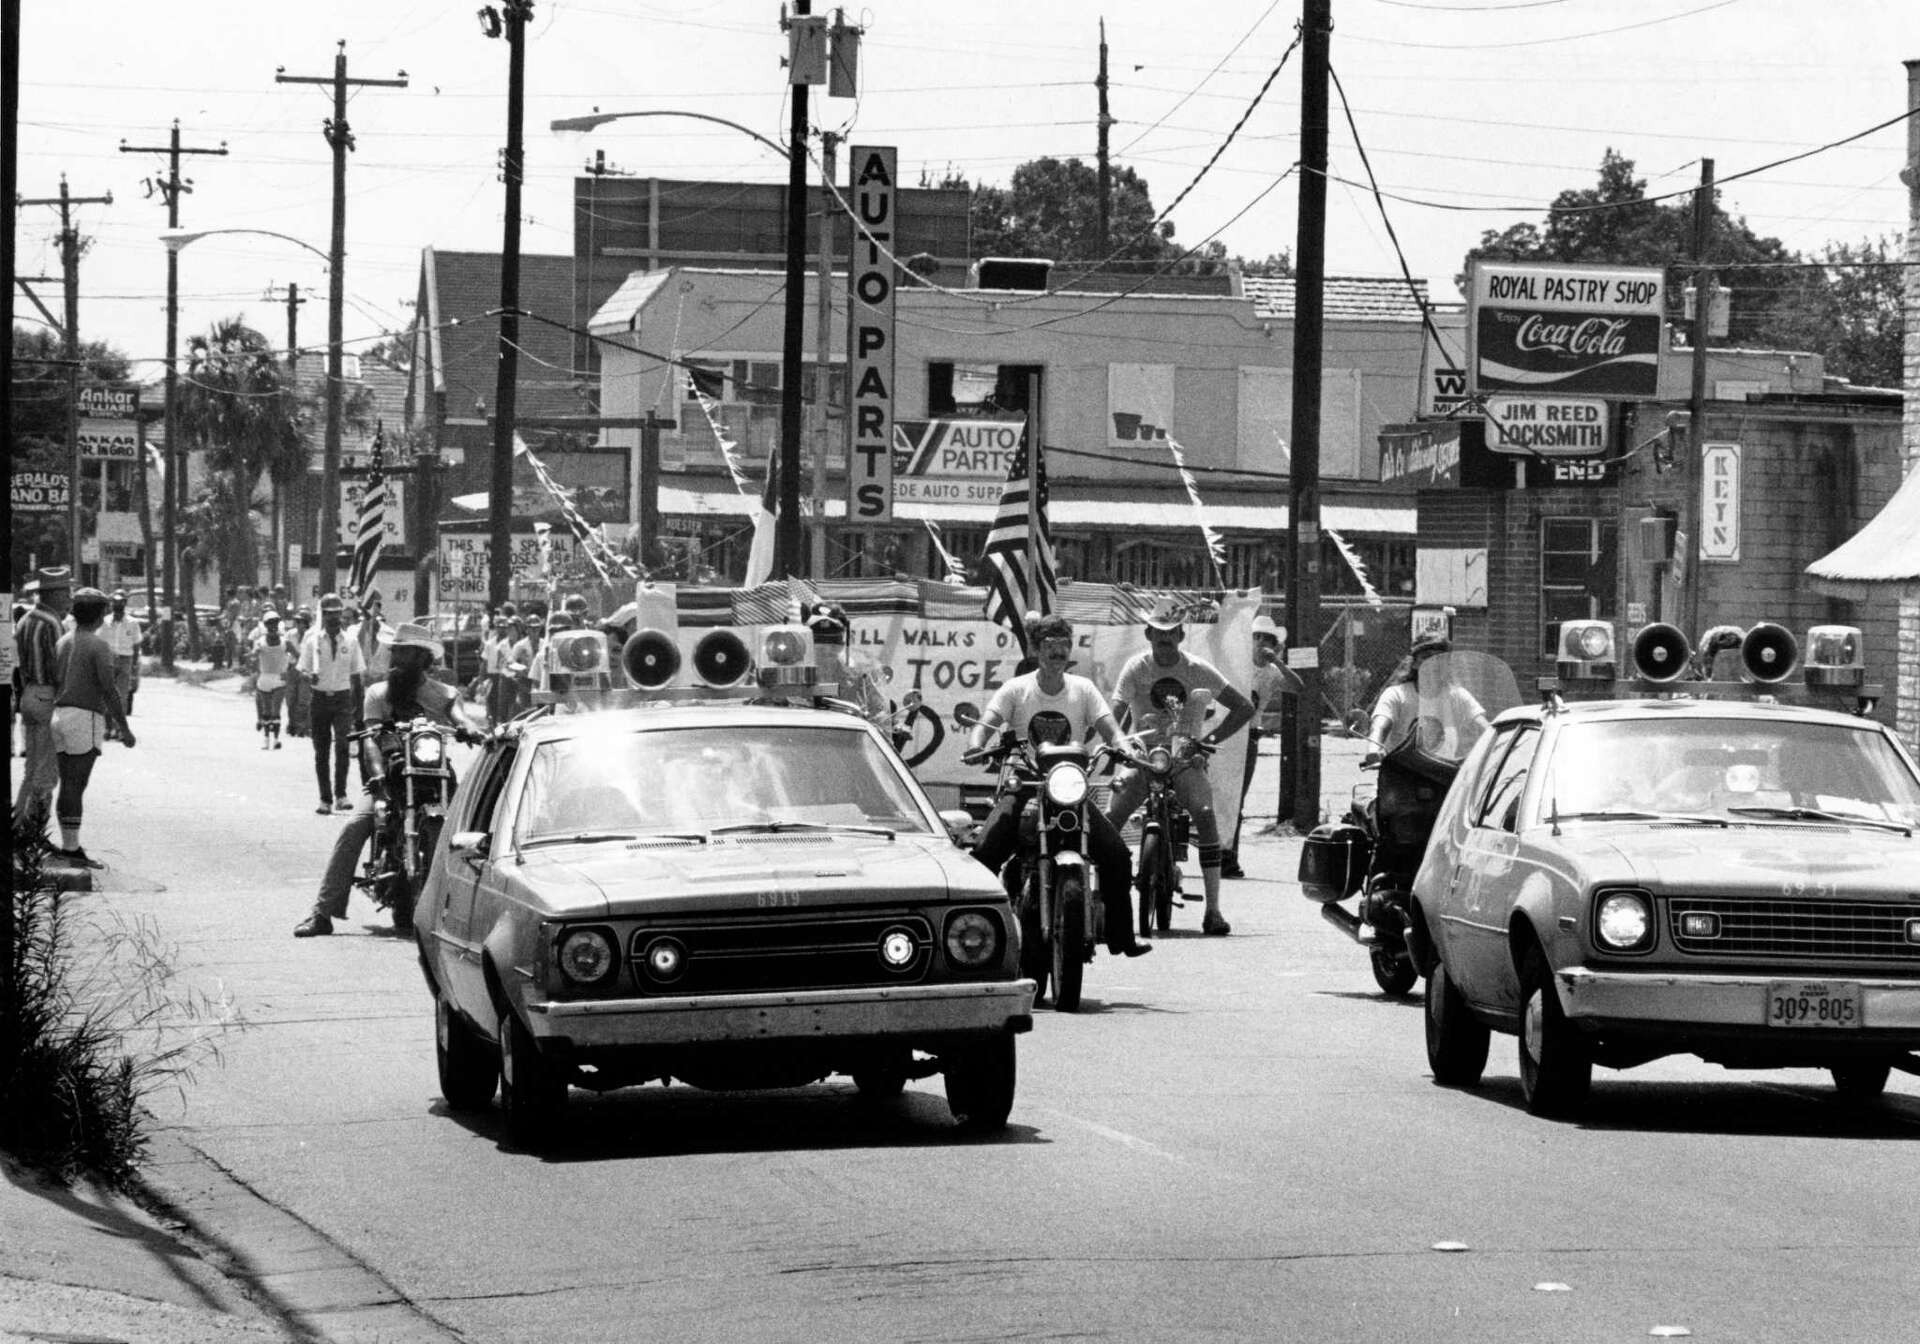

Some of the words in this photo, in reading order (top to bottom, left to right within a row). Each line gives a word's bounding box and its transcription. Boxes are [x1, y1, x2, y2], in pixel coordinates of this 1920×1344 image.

[857, 152, 891, 304] AUTO
[1489, 275, 1538, 300] ROYAL
[1543, 278, 1609, 302] PASTRY
[1614, 281, 1658, 305] SHOP
[1515, 314, 1632, 355] Coca-Cola
[80, 388, 135, 403] Ankar
[856, 326, 889, 517] PARTS
[1501, 404, 1537, 421] JIM
[1546, 405, 1599, 423] REED
[950, 427, 1016, 449] AUTO
[1499, 424, 1602, 446] LOCKSMITH
[943, 450, 1015, 471] PARTS
[923, 485, 960, 499] AUTO
[967, 486, 1004, 500] SUPP
[447, 539, 475, 552] THIS
[511, 553, 541, 566] OSES
[440, 580, 486, 593] SPRING
[902, 629, 976, 647] WALKS
[906, 658, 1005, 691] TOGE
[1773, 997, 1855, 1021] 309-805
